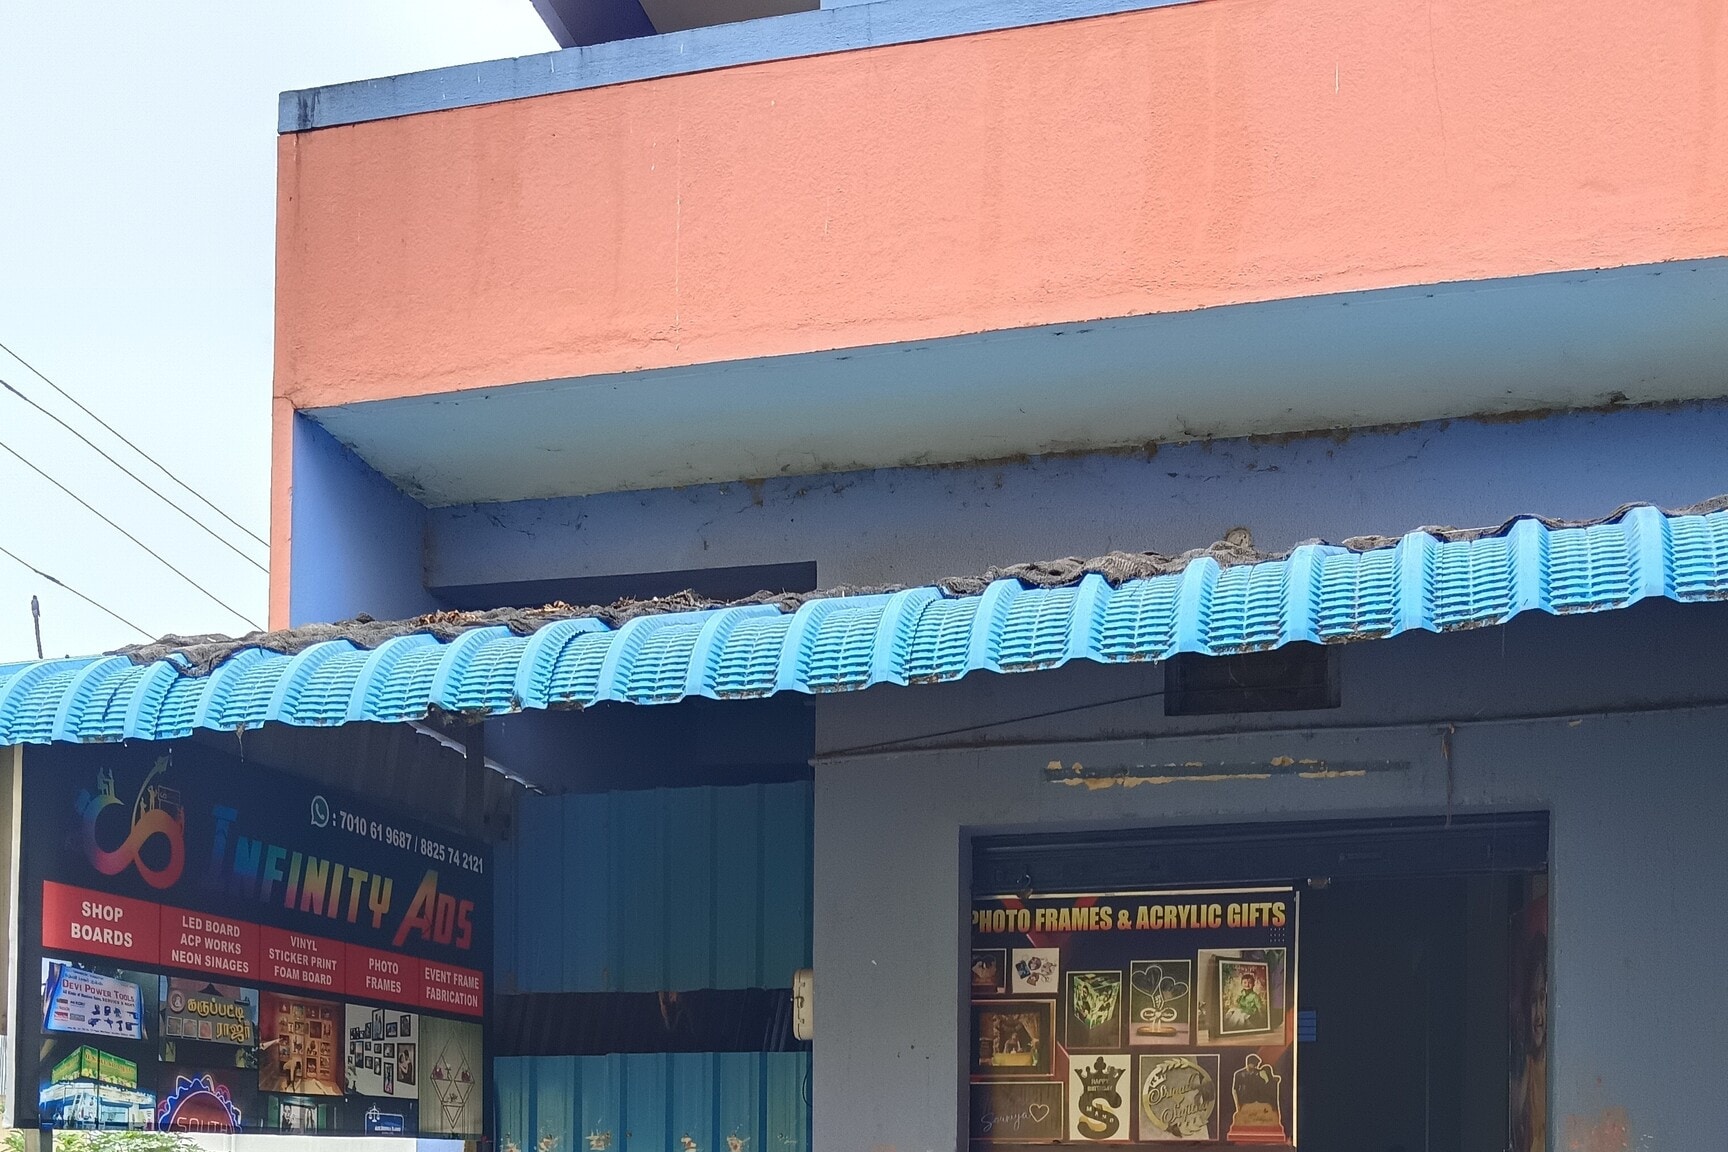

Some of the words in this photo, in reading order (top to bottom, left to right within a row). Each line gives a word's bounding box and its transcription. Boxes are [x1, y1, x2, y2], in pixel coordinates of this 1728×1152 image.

[340, 810, 367, 836] 7010
[370, 821, 382, 841] 61
[386, 826, 412, 850] 9687
[420, 838, 445, 862] 8825
[448, 847, 460, 867] 74
[462, 852, 483, 874] 2121
[81, 901, 123, 922] SHOP
[1035, 906, 1112, 932] FRAMES
[1117, 910, 1132, 930] &
[1136, 903, 1222, 930] ACRYLIC
[1227, 902, 1286, 928] GIFTS
[71, 922, 133, 948] BOARDS
[182, 915, 202, 930] LED
[205, 920, 240, 937] BOARD
[180, 933, 201, 947] ACP
[204, 937, 242, 955] WORKS
[290, 935, 317, 951] VINYL
[171, 949, 201, 966] NEON
[204, 955, 249, 973] SINAGES
[269, 948, 309, 966] STICKER
[311, 956, 337, 971] PRINT
[368, 958, 399, 975] PHOTO
[274, 965, 300, 980] FOAM
[302, 970, 332, 986] BOARD
[366, 975, 401, 993] FRAMES
[424, 967, 451, 983] EVENT
[453, 973, 479, 990] FRAME
[62, 979, 83, 991] DEVI
[84, 984, 112, 998] POWER
[114, 990, 135, 1002] TOOLS
[426, 986, 478, 1008] FABRICATION
